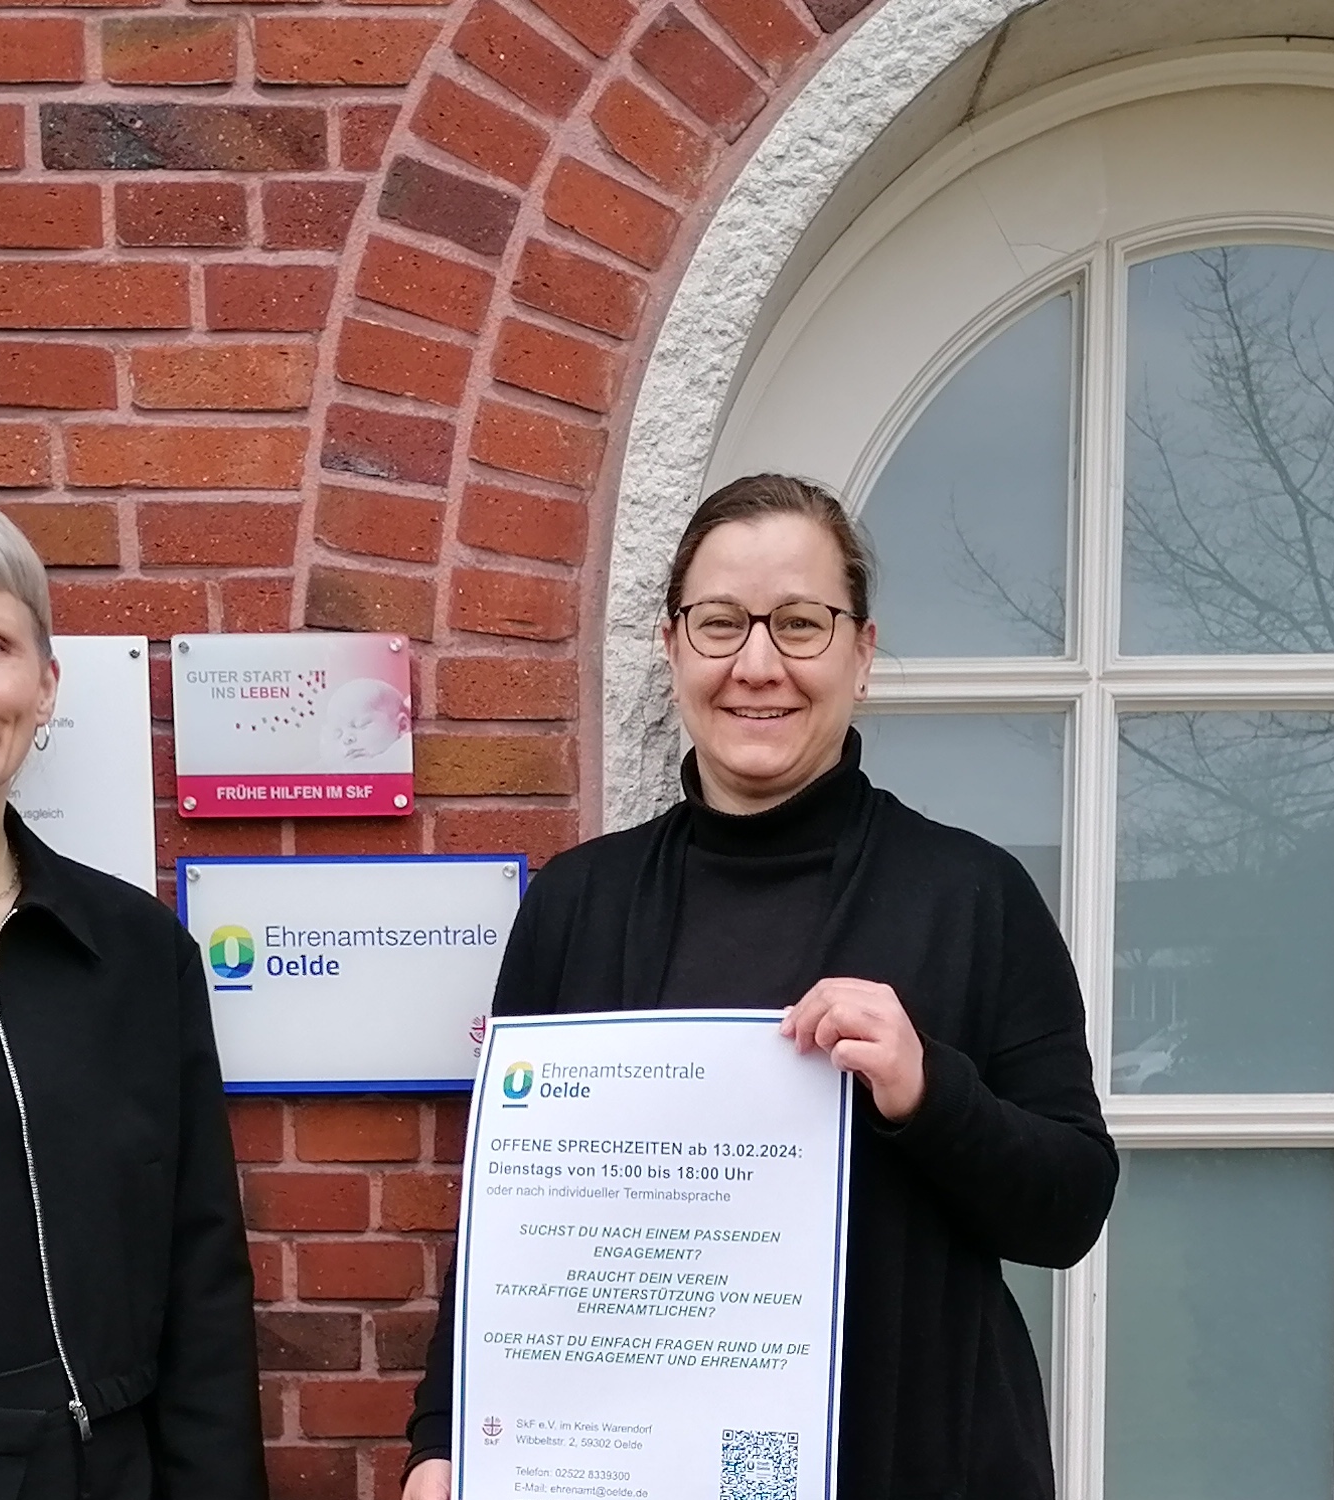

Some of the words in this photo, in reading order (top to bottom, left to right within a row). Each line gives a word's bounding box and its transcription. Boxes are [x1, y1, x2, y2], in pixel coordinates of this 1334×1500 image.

[186, 670, 239, 684] GUTER
[243, 670, 292, 684] START
[211, 687, 236, 699] INS
[240, 686, 290, 699] LEBEN
[217, 784, 267, 800] FRÜHE
[270, 786, 323, 799] HILFEN
[326, 785, 343, 799] IM
[346, 785, 373, 799] SkF
[265, 924, 497, 947] Ehrenamtszentrale
[267, 954, 340, 977] Oelde
[541, 1062, 705, 1080] Ehrenamtszentrale
[540, 1082, 591, 1099] Oelde
[491, 1138, 552, 1152] OFFENE
[557, 1139, 683, 1155] SPRECHZEITEN
[688, 1143, 707, 1156] ab
[713, 1143, 803, 1159] 13.02.2024:
[488, 1162, 562, 1179] Dienstags
[568, 1166, 595, 1177] von
[601, 1164, 643, 1179] 15:00
[647, 1165, 671, 1179] bis
[678, 1166, 719, 1180] 18:00
[724, 1168, 754, 1181] Uhr
[486, 1185, 513, 1196] oder
[516, 1185, 545, 1197] nach
[548, 1185, 620, 1199] individueller
[623, 1187, 731, 1203] Terminabsprache
[519, 1224, 575, 1237] SUCHST
[578, 1225, 598, 1238] DU
[601, 1227, 643, 1240] NACH
[646, 1228, 691, 1241] EINEM
[694, 1229, 781, 1243] PASSENDEN
[593, 1246, 702, 1261] ENGAGEMENT?
[566, 1270, 636, 1284] BRAUCHT
[639, 1272, 673, 1284] DEIN
[677, 1273, 728, 1286] VEREIN
[495, 1283, 588, 1299] TATKRÄFTIGE
[592, 1287, 715, 1303] UNTERSTÜTZUNG
[720, 1292, 750, 1304] VON
[753, 1293, 802, 1306] NEUEN
[577, 1302, 716, 1318] EHRENAMTLICHEN?
[483, 1332, 523, 1345] ODER
[526, 1333, 565, 1346] HAST
[567, 1335, 587, 1347] DU
[590, 1336, 652, 1349] EINFACH
[654, 1338, 714, 1352] FRAGEN
[716, 1340, 758, 1354] RUND
[761, 1342, 784, 1355] UM
[786, 1343, 810, 1356] DIE
[504, 1348, 562, 1361] THEMEN
[565, 1350, 664, 1366] ENGAGEMENT
[667, 1354, 697, 1367] UND
[700, 1356, 788, 1371] EHRENAMT?
[516, 1419, 536, 1429] SkF
[559, 1421, 572, 1431] im
[574, 1421, 599, 1432] Kreis
[602, 1423, 653, 1434] Warendorf
[484, 1438, 500, 1446] SkF
[516, 1435, 567, 1446] Wibbeltstr.
[568, 1437, 578, 1448] 2,
[581, 1438, 611, 1449] 59302
[614, 1439, 643, 1450] Oelde
[516, 1466, 552, 1477] Telefon:
[555, 1468, 585, 1479] 02522
[587, 1470, 630, 1481] 8339300
[514, 1482, 548, 1493] E-Mail:
[550, 1485, 648, 1499] ehrenamt@oelde.de
